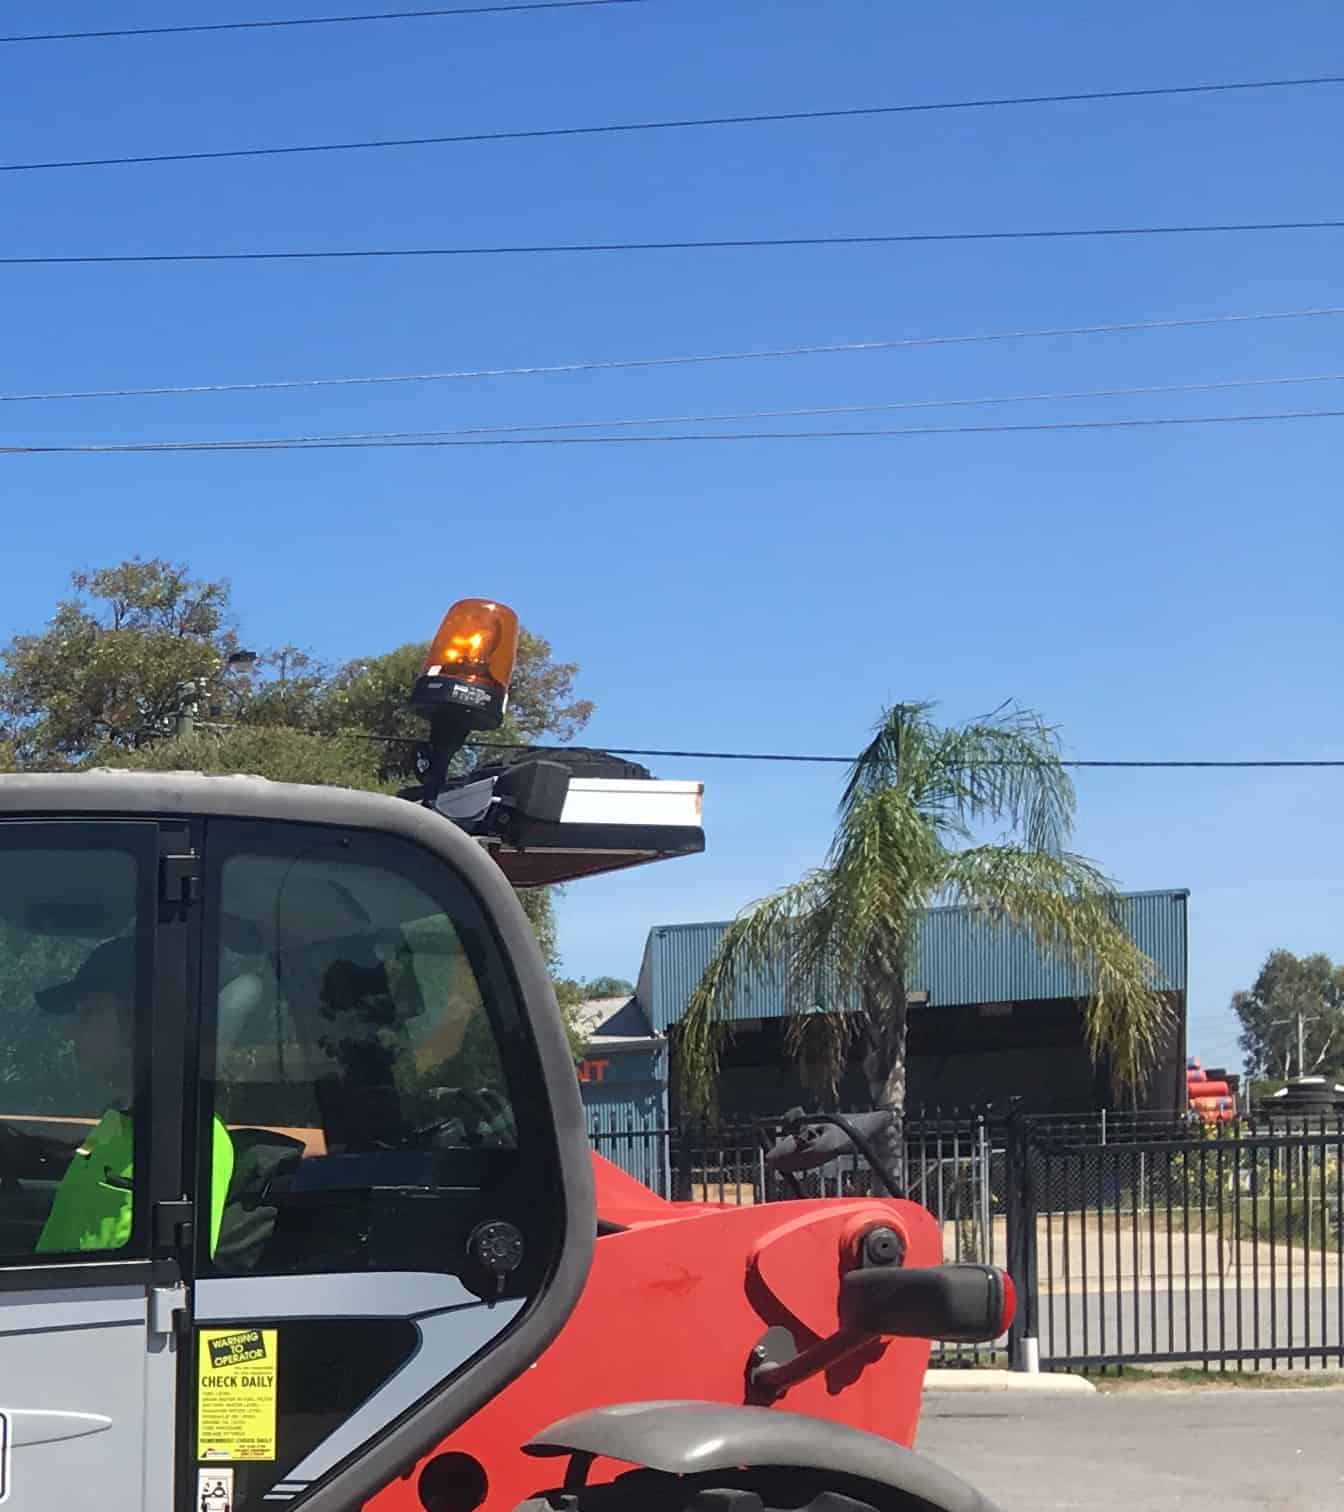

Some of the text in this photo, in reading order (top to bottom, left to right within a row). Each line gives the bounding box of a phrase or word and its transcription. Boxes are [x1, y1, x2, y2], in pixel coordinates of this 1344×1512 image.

[213, 1332, 258, 1348] WARNING
[231, 1345, 244, 1354] TO
[215, 1349, 264, 1366] OPERATOR
[201, 1376, 273, 1388] CHECK DAILY
